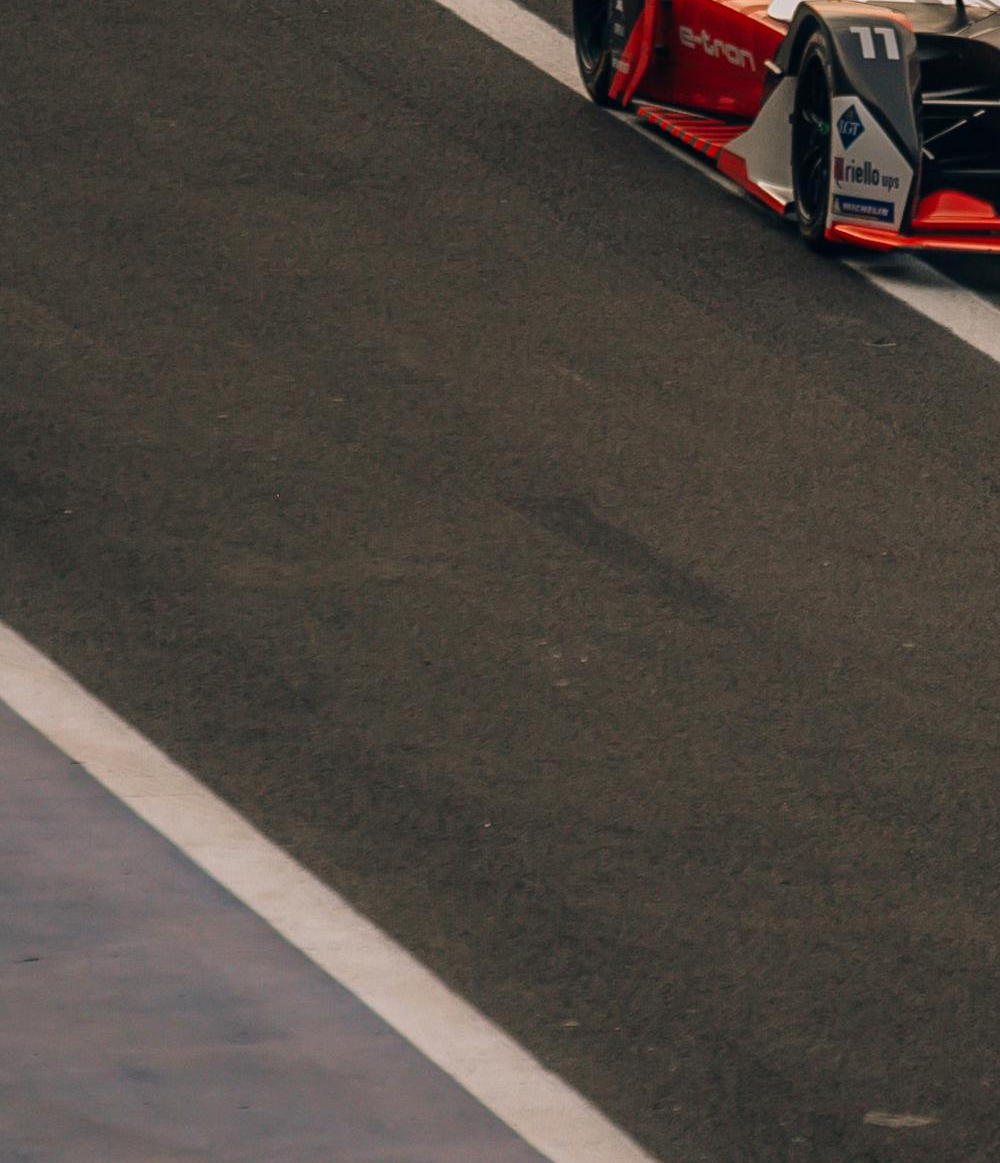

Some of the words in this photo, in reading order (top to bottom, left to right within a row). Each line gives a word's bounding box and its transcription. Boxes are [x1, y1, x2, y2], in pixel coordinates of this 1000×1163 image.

[679, 25, 756, 72] e-tron
[849, 26, 900, 61] 11
[845, 159, 880, 186] riello
